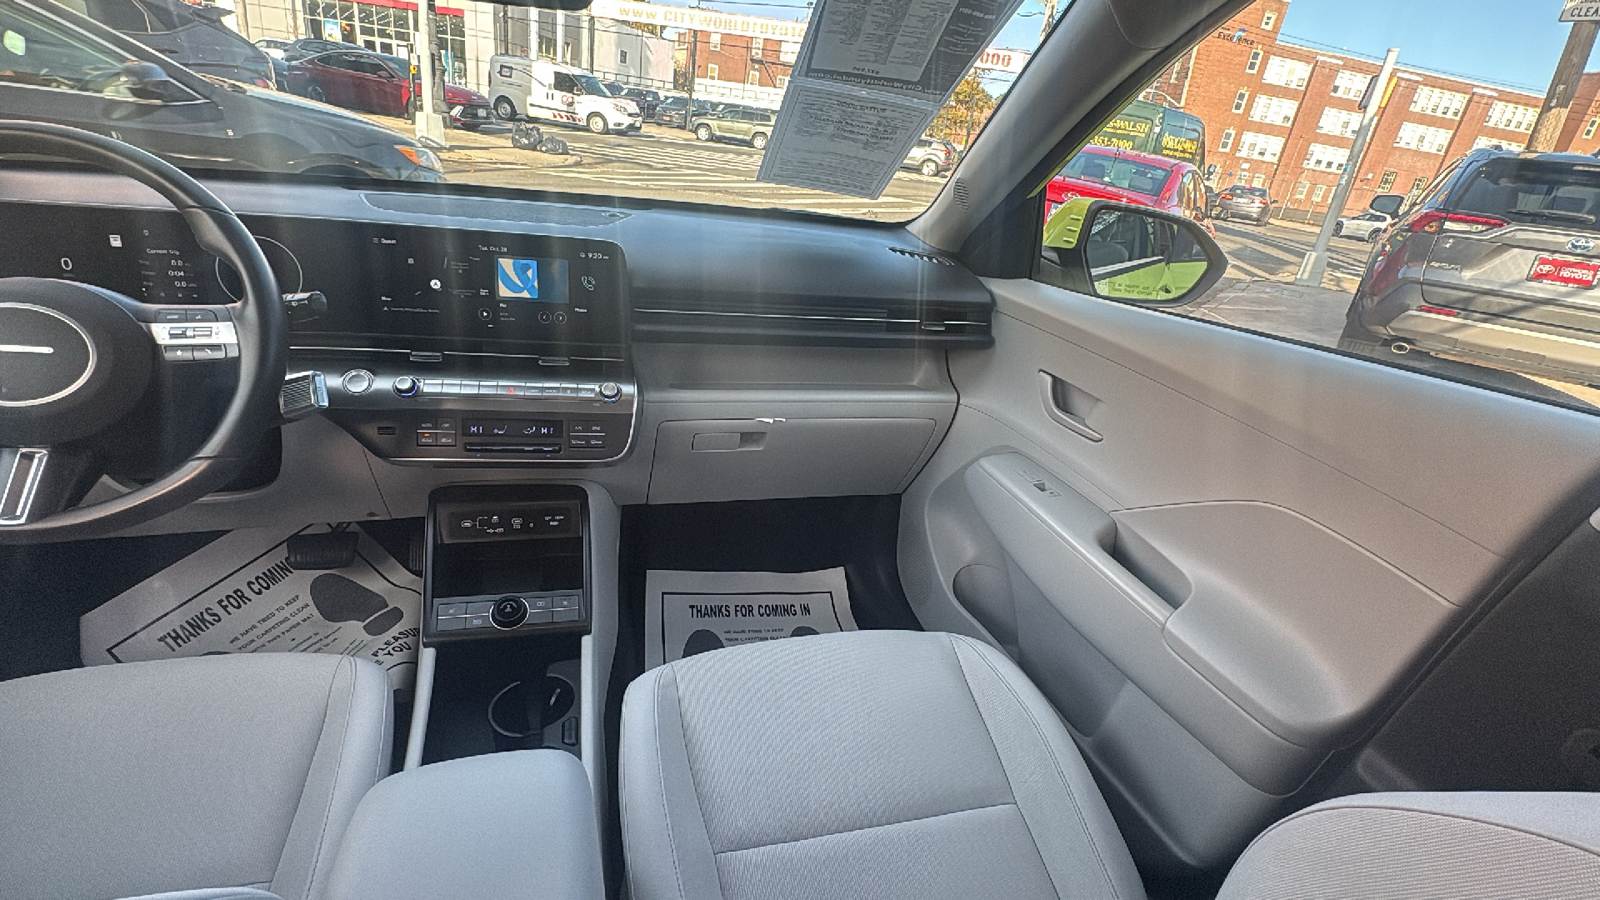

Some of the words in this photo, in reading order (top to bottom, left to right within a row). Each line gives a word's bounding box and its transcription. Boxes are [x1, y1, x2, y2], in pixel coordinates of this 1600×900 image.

[61, 257, 73, 270] 0
[688, 604, 731, 619] THANKS
[734, 604, 755, 618] FOR
[757, 603, 798, 618] COMING
[799, 603, 811, 616] IN
[157, 606, 223, 653] THANKS
[216, 587, 253, 616] FOR
[382, 641, 412, 657] YOU
